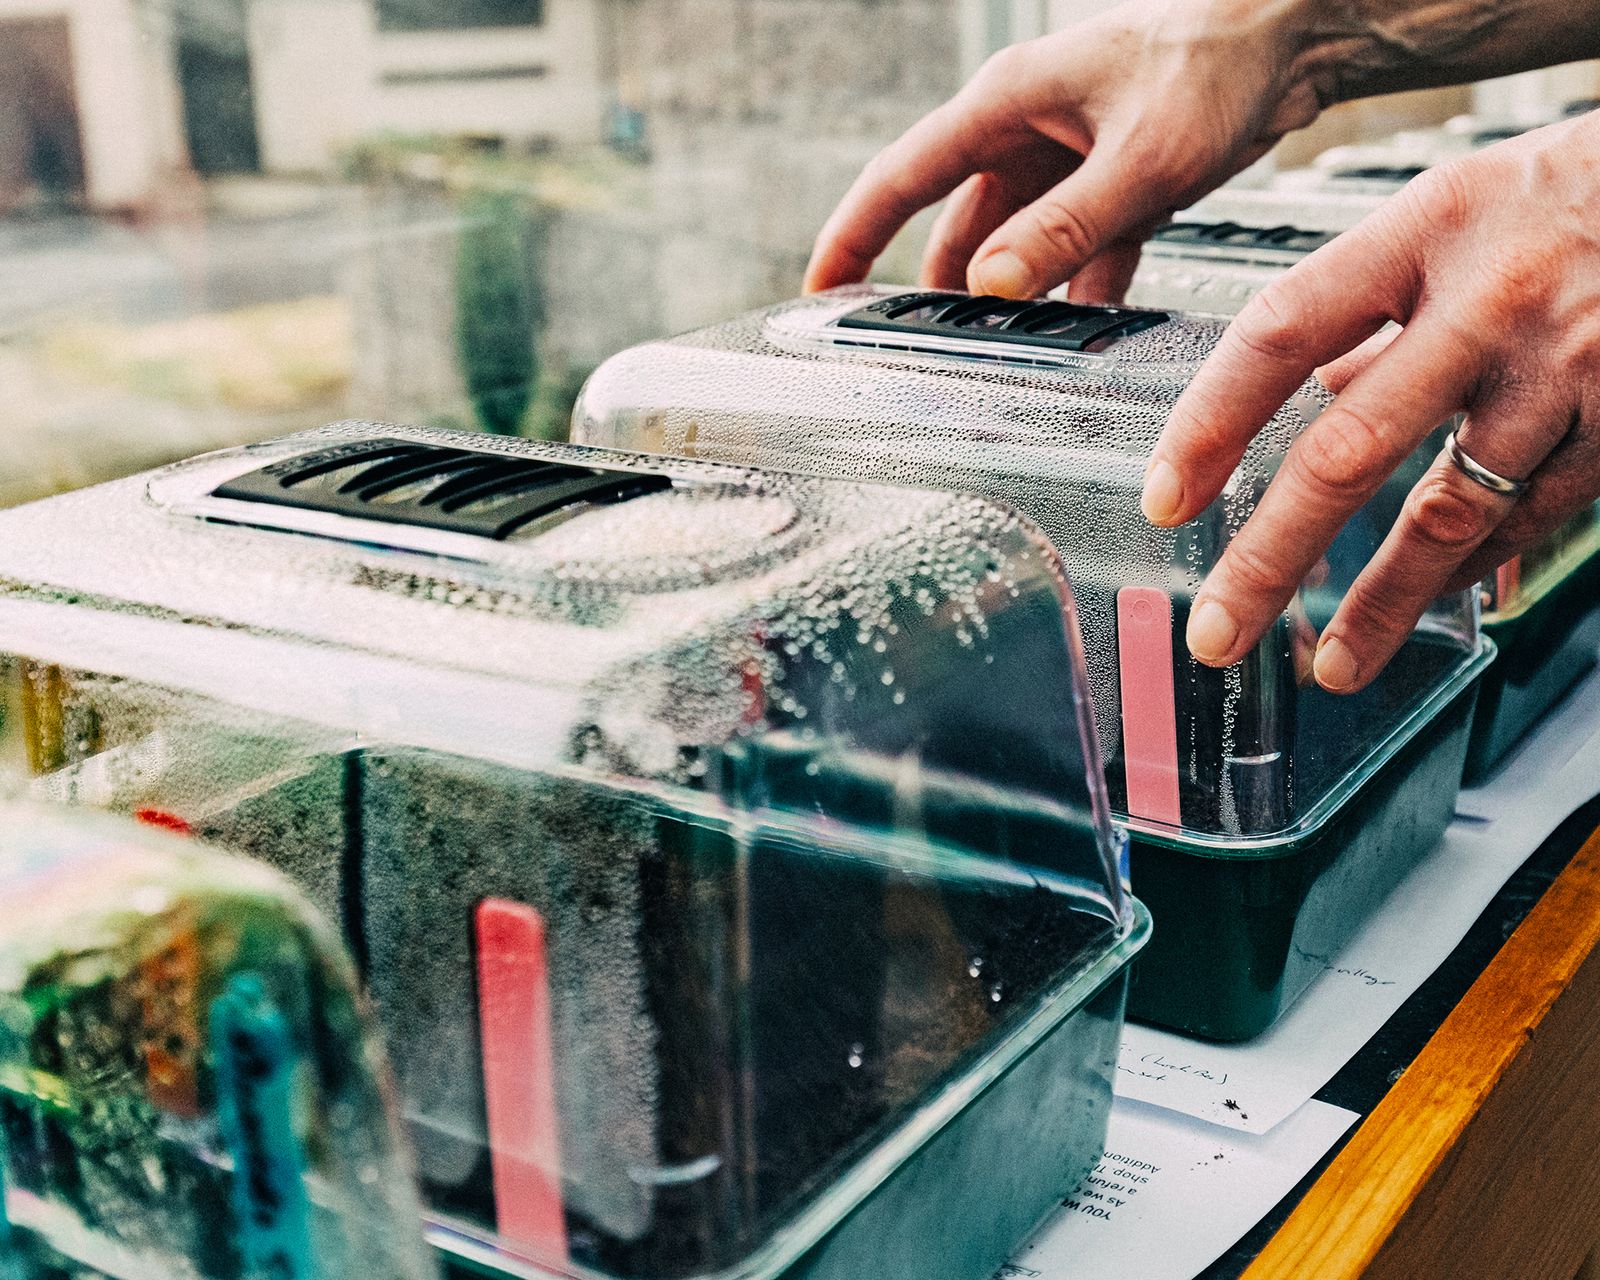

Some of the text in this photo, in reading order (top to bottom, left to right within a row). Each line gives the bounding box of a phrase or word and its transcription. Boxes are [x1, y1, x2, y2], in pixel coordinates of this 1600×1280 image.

[1084, 1176, 1125, 1192] refun
[1112, 1168, 1149, 1185] shop.
[1083, 1190, 1104, 1201] we
[1106, 1197, 1126, 1208] As
[1081, 1205, 1111, 1220] YOU
